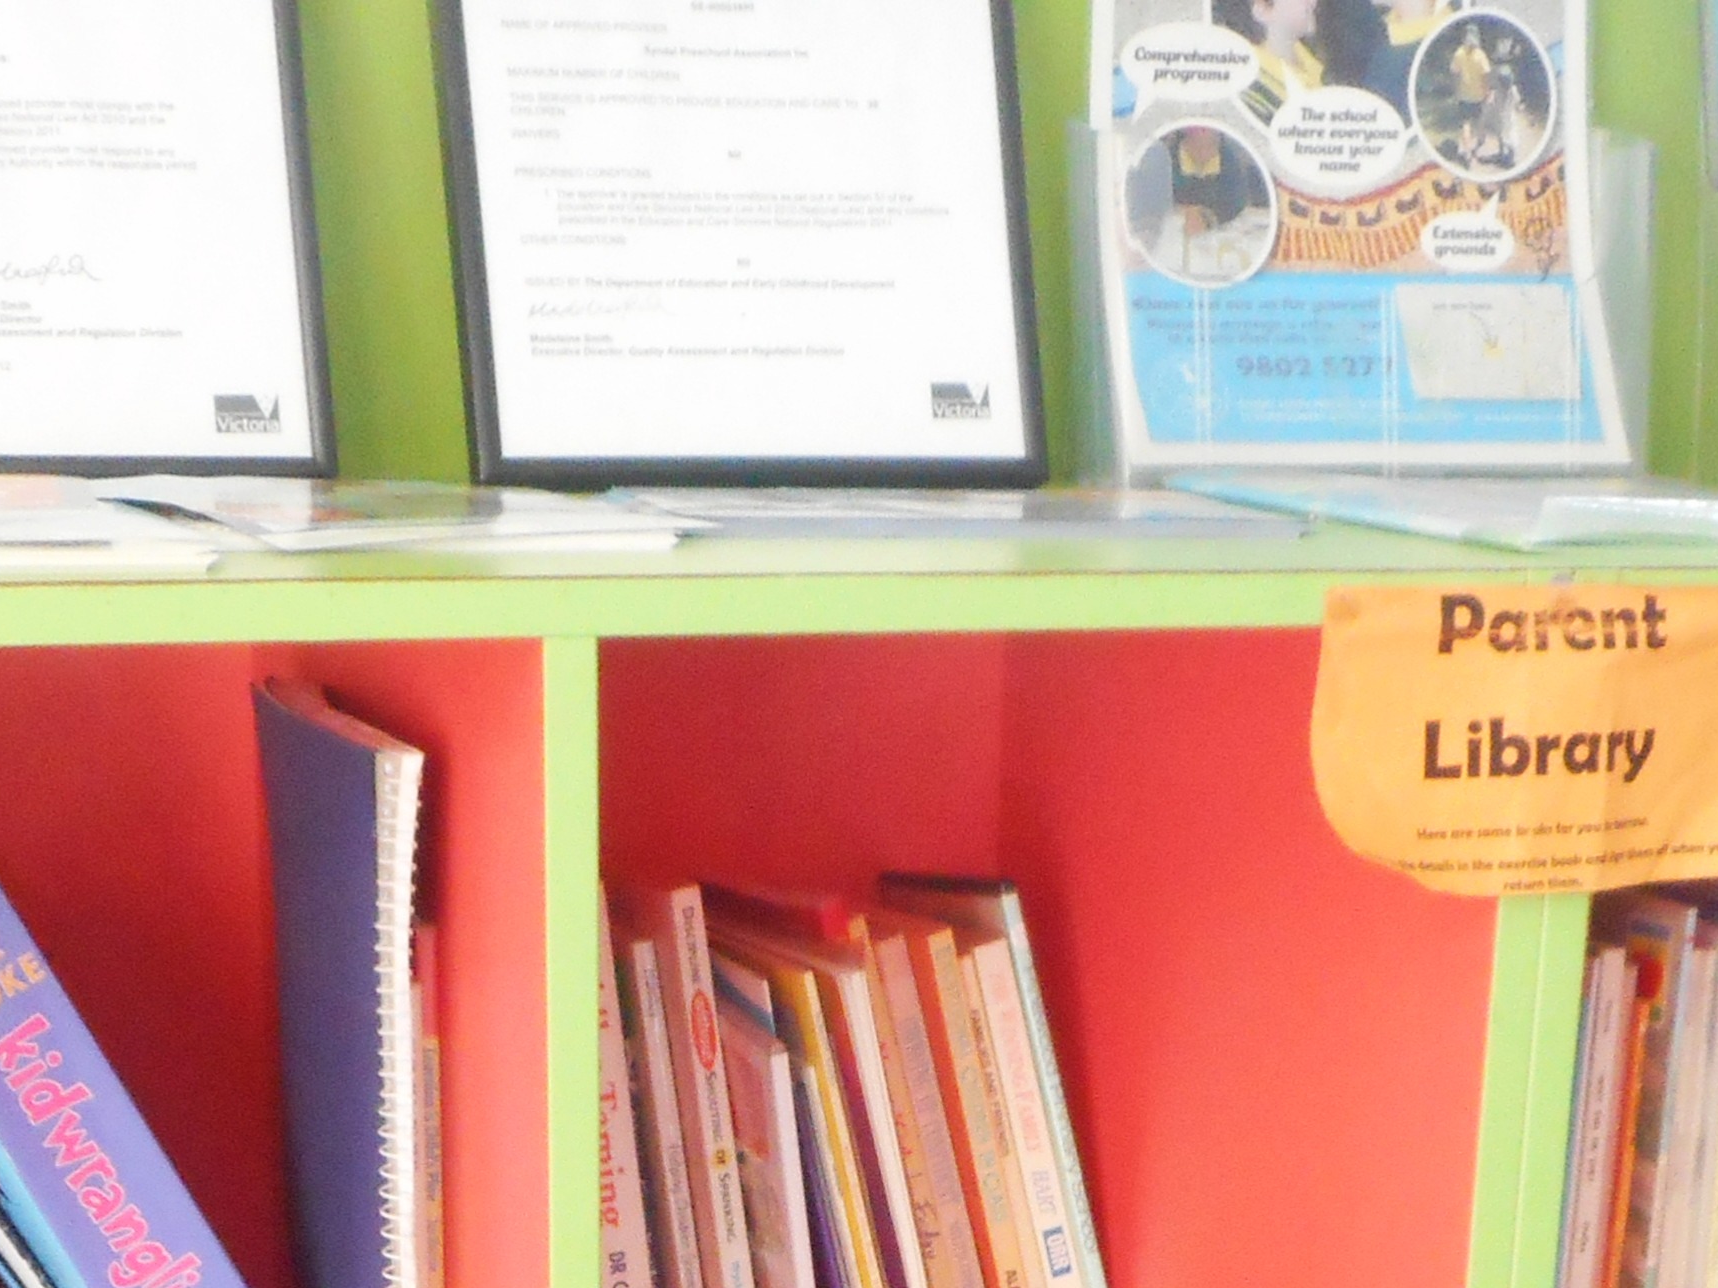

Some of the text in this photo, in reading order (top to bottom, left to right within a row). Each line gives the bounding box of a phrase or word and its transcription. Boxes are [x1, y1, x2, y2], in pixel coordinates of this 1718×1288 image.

[1134, 46, 1250, 66] Comprehensive
[1153, 66, 1230, 83] programs
[1300, 107, 1377, 123] The school
[1278, 126, 1399, 144] where everyone
[1293, 142, 1384, 160] knows your
[1318, 160, 1361, 173] name
[1432, 225, 1503, 241] Extensive
[1434, 241, 1496, 258] grounds
[933, 404, 990, 421] Victoria
[217, 413, 281, 433] Victoria
[1437, 593, 1669, 655] Parent
[1423, 716, 1656, 784] Library
[608, 1251, 625, 1275] DR
